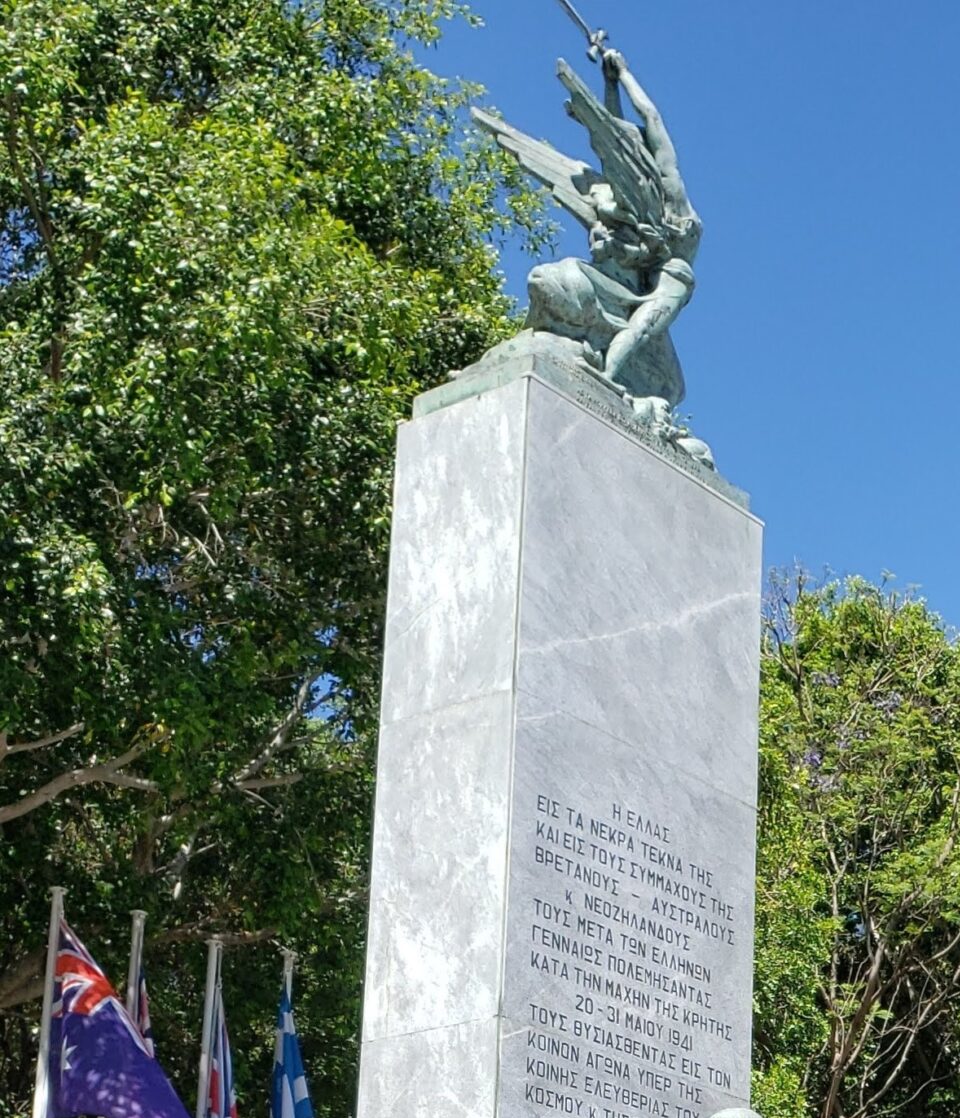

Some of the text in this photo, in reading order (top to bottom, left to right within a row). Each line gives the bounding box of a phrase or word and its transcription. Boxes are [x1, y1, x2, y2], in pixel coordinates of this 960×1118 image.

[537, 795, 713, 888] ΕΙΣ ΤΑ ΝΕΚΡΑ ΤΕΚΝΑ ΤΗΣ
[613, 804, 670, 843] Η ΕΛΛΑΣ
[536, 821, 734, 921] ΚΑΙ ΕΙΣ ΤΟΥΣ ΣΥΜΜΑΧΟΥΣ ΤΗΣ
[536, 847, 619, 895] ΒΡΕΤΑΝΟΥΣ
[652, 898, 735, 945] ΑΥΣΤΡΑΛΟΥΣ
[533, 899, 711, 983] ΤΟΥΣ ΜΕΤΑ ΤΩΝ ΕΛΛΗΝΩΝ
[585, 894, 690, 951] ΝΕΟΖΗΛΑΝΔΟΥΣ
[531, 951, 732, 1041] ΚΑΤΑ ΤΗΝ ΜΑΧΗΝ ΤΗΣ ΚΡΗΤΗΣ
[532, 926, 712, 1009] ΓΕΝΝΑΙΩΣ ΠΟΛΕΜΗΣΑΝΤΑΣ
[528, 1031, 702, 1104] ΚΟΙΝΟΝ ΑΓΩΝΑ ΥΠΕΡ ΤΗΣ
[529, 1004, 731, 1089] ΤΟΥΣ ΘΥΣΙΑΣΘΕΝΤΑΣ ΕΙΣ ΤΟΝ
[626, 1013, 664, 1041] ΜΑΙΟΥ
[669, 1028, 693, 1052] 1941
[525, 1084, 583, 1115] ΚΟΣΜΟΥ
[526, 1057, 578, 1088] ΚΟΙΝΗΣ
[585, 1077, 669, 1118] ΕΛΕΥΘΕΡΙΑΣ
